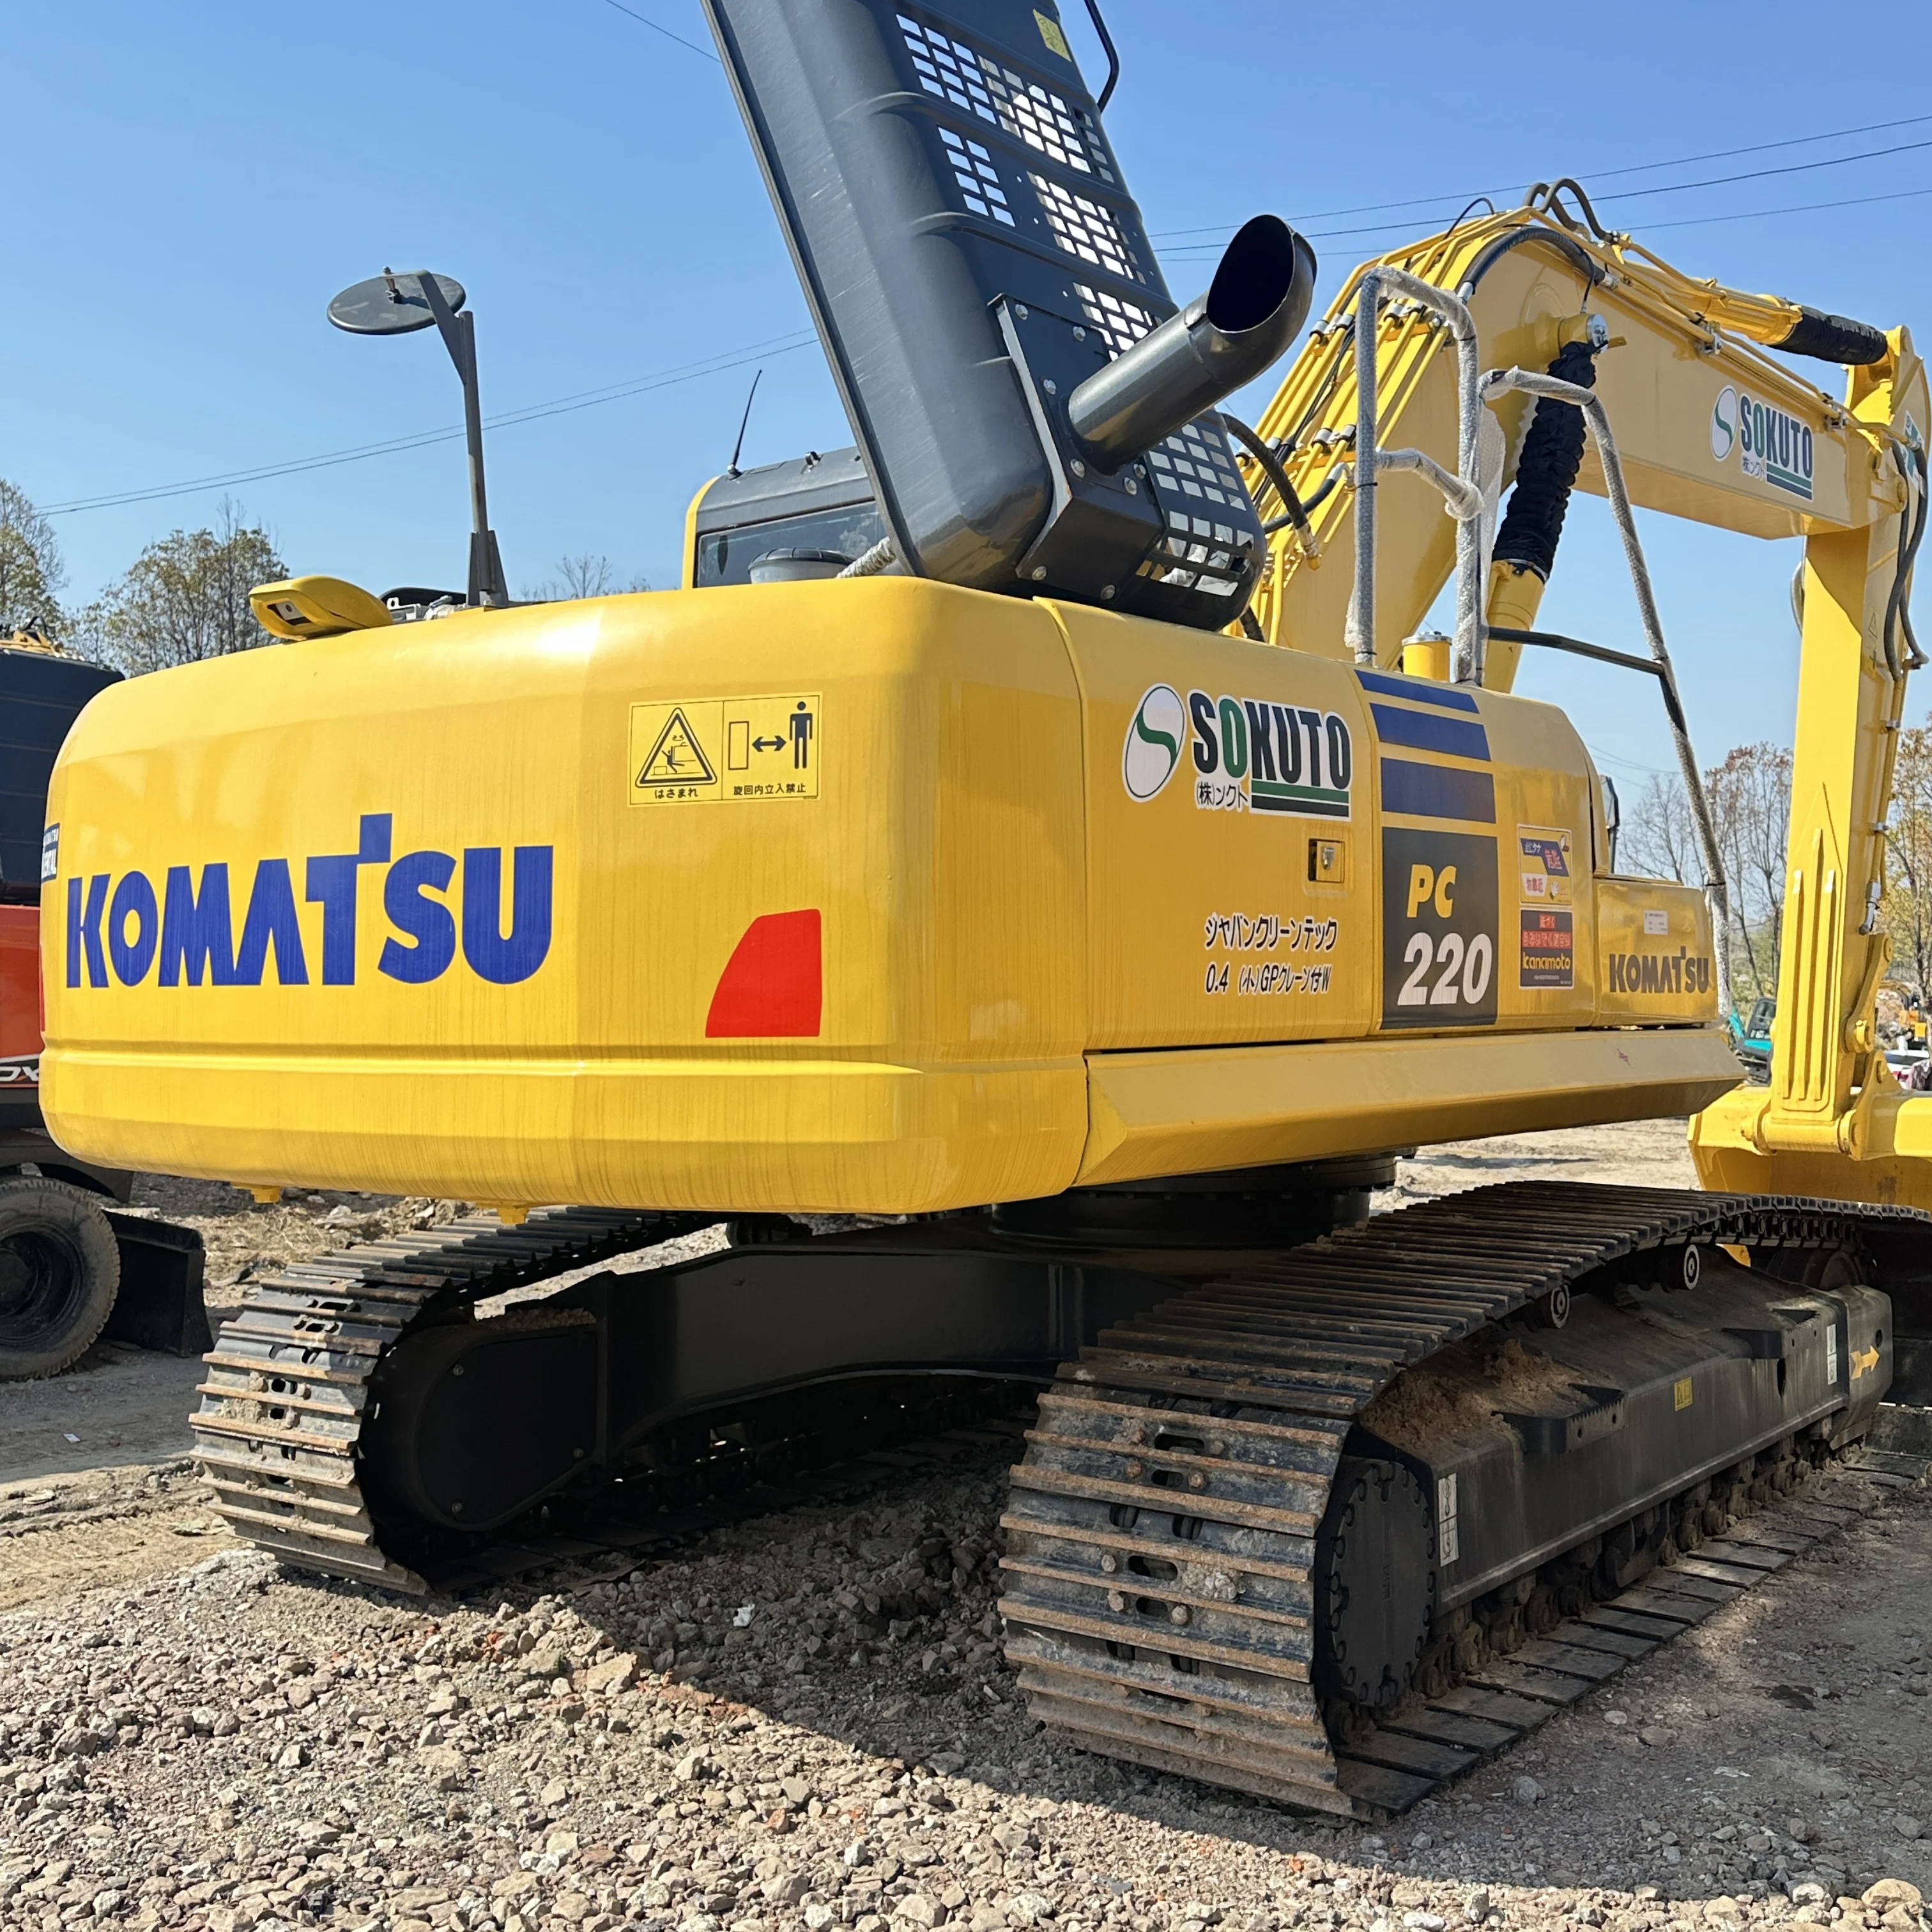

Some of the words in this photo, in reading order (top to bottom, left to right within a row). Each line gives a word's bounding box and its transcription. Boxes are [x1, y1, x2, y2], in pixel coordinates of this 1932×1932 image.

[1740, 395, 1813, 479] SOKUTO
[1190, 693, 1351, 790] SOKUTO
[654, 787, 699, 799] はさまれ
[733, 783, 806, 796] 旋回内立入禁止
[66, 813, 553, 988] KOMATSU
[1407, 864, 1457, 918] PC
[1206, 963, 1229, 993] 0.4
[1397, 932, 1492, 1006] 220
[1522, 951, 1570, 970] kanamoto
[1609, 946, 1709, 994] KOMATSU
